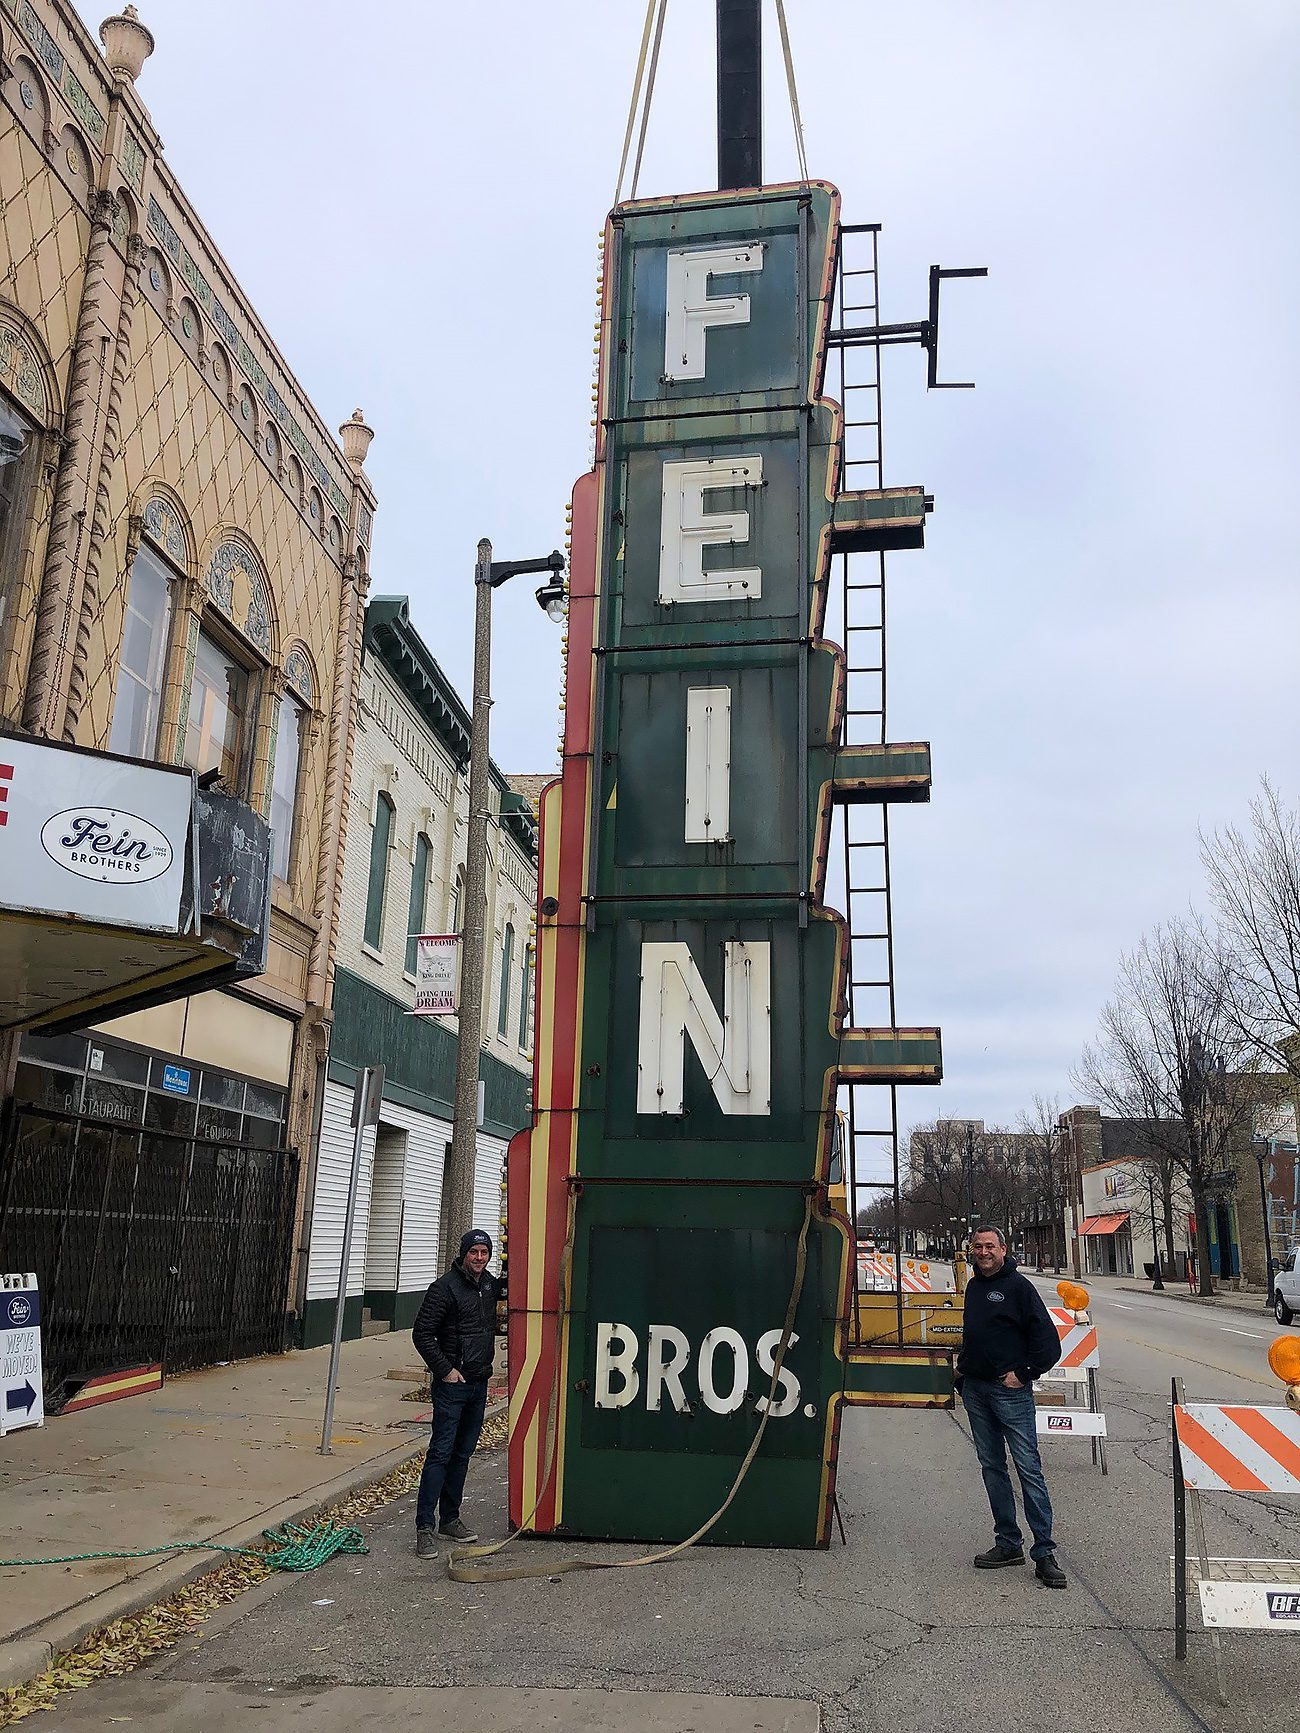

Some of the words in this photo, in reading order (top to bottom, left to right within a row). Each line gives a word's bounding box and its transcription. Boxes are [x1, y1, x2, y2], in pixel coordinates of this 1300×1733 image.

[637, 240, 770, 1116] FEIN
[61, 817, 152, 860] Fein
[71, 852, 140, 872] BROTHERS
[417, 998, 453, 1008] DREAM
[7, 1332, 34, 1354] WE'VE
[2, 1353, 38, 1378] MOVED!
[594, 1322, 818, 1418] BROS.
[1049, 1417, 1071, 1427] BFS
